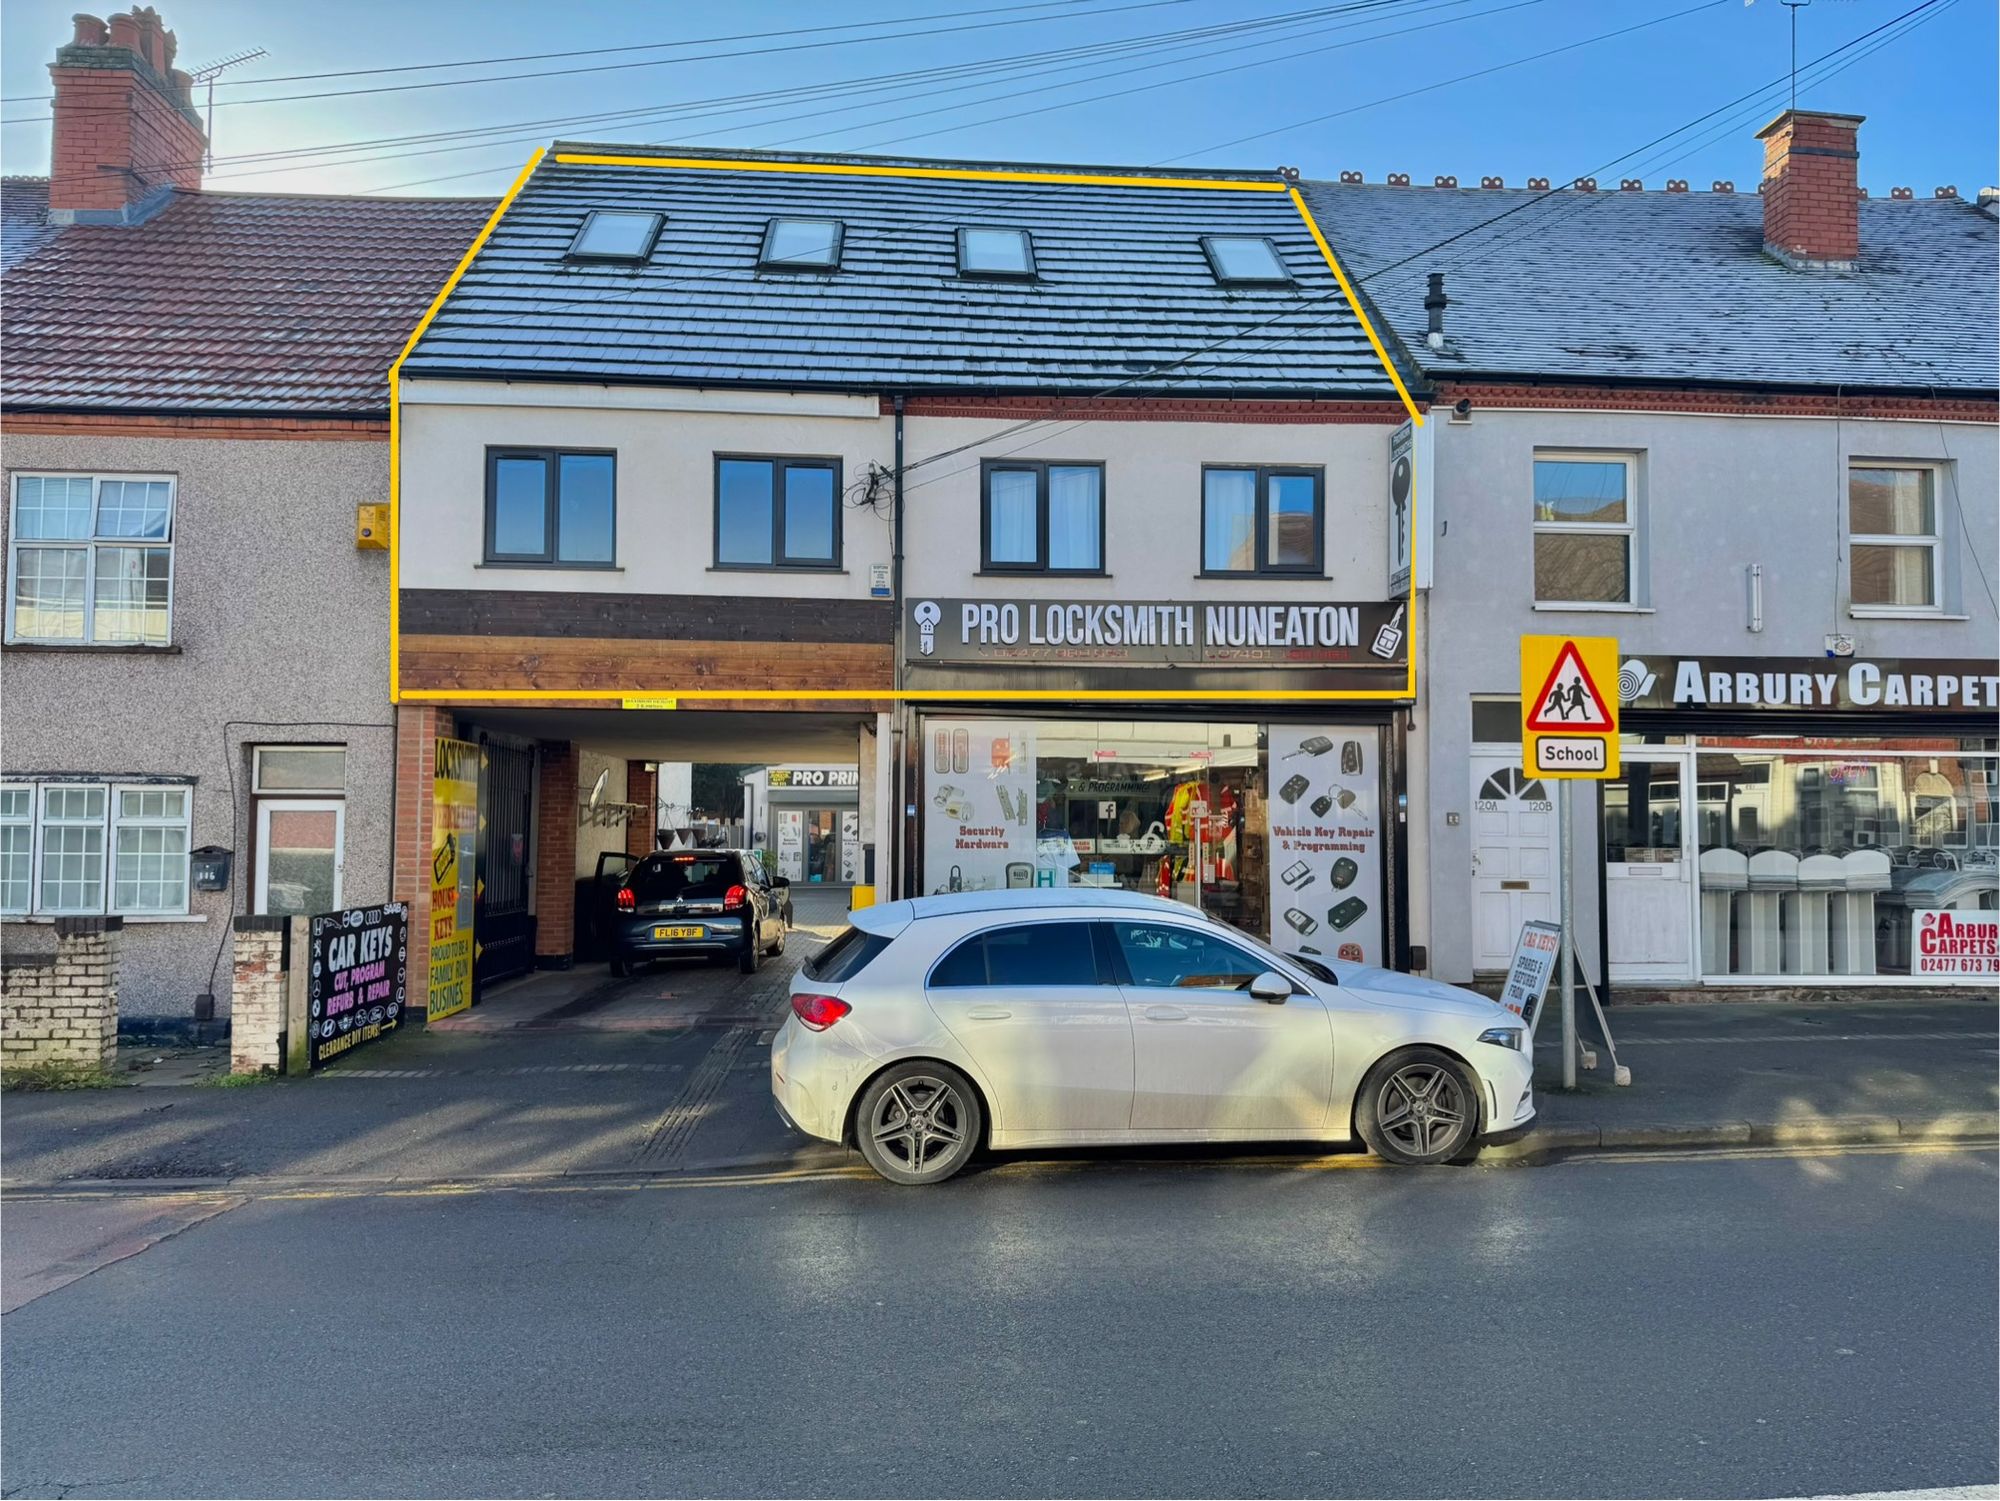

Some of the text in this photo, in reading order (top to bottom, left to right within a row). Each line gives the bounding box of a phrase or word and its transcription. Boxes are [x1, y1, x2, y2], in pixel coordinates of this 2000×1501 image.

[961, 603, 1359, 648] PRO LOCKSMITH NUNEATON
[1673, 660, 1999, 707] ARBURY CARPET
[434, 738, 478, 782] LOCKS
[1545, 745, 1598, 761] School
[792, 771, 824, 785] PRO
[1078, 782, 1150, 793] & PROGRAMMING
[1474, 801, 1497, 811] 120A
[1529, 801, 1552, 811] 120B
[960, 826, 1005, 838] Security
[1273, 826, 1375, 839] Vehicle Key Repair
[955, 839, 1009, 849] Hardware
[1282, 840, 1365, 853] & Programming
[200, 872, 215, 880] 116
[432, 886, 456, 912] HOUSE
[383, 903, 402, 915] SAAB
[434, 916, 453, 941] KEYS
[660, 928, 678, 937] FL16
[328, 925, 393, 972] CAR KEYS
[1523, 931, 1557, 952] CAR KEYS
[1920, 928, 1996, 954] CARPETS
[1517, 955, 1539, 973] SPARES
[1921, 959, 1956, 971] 02477
[1961, 959, 1982, 972] 673
[351, 961, 385, 986] PROGRAM
[430, 962, 453, 986] FAMILY
[326, 991, 354, 1016] REFURB
[367, 980, 390, 1001] REPAIR
[429, 980, 464, 1015] BUSINES
[318, 1033, 351, 1061] CLEARANCE
